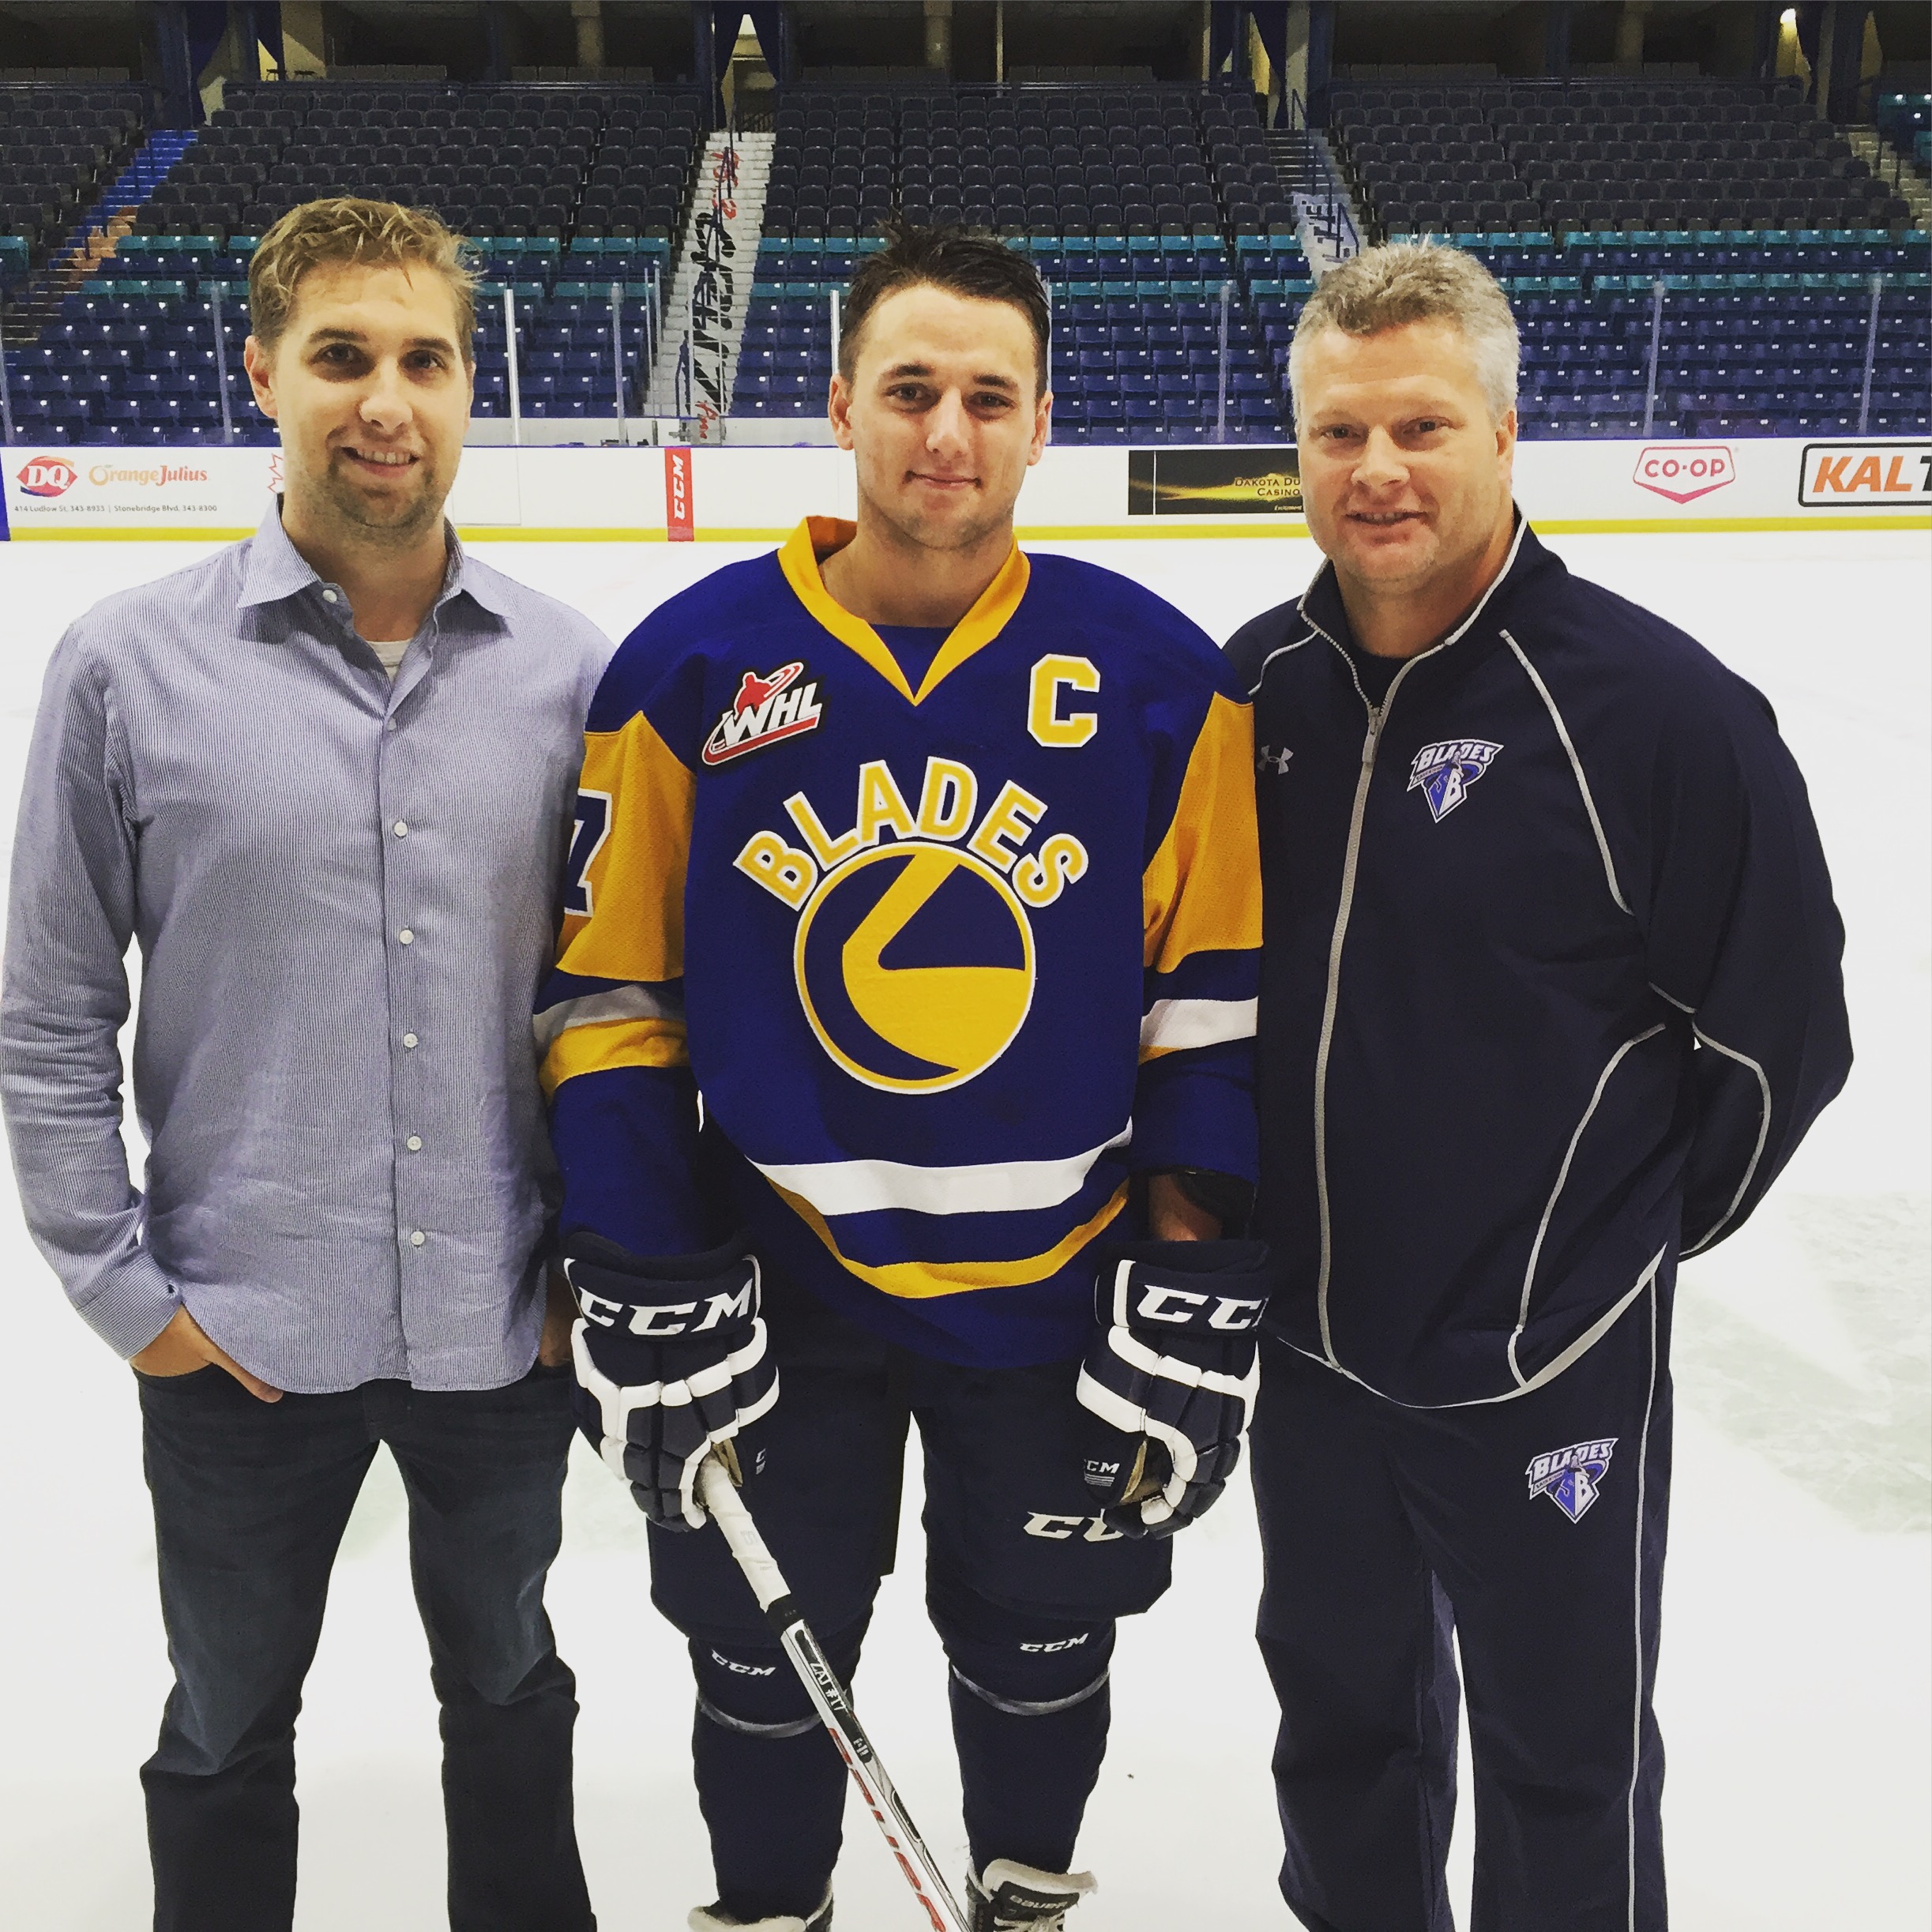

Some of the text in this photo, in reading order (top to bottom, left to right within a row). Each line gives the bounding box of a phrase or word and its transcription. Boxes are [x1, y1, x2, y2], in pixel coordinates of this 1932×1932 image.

[27, 465, 70, 489] DQ
[672, 454, 686, 520] CCM
[1235, 478, 1280, 487] DAKOTA
[1257, 487, 1300, 496] CASINO
[114, 505, 160, 513] Stonebridge
[722, 682, 822, 746] WHL
[1028, 653, 1100, 747] C
[1415, 743, 1497, 773] BLADES
[732, 756, 1089, 911] BLADES
[578, 1278, 754, 1336] CCM
[1136, 1284, 1270, 1330] CC
[1533, 1442, 1611, 1483] BLADES
[1020, 1633, 1089, 1652] CCM
[712, 1648, 776, 1676] CCM
